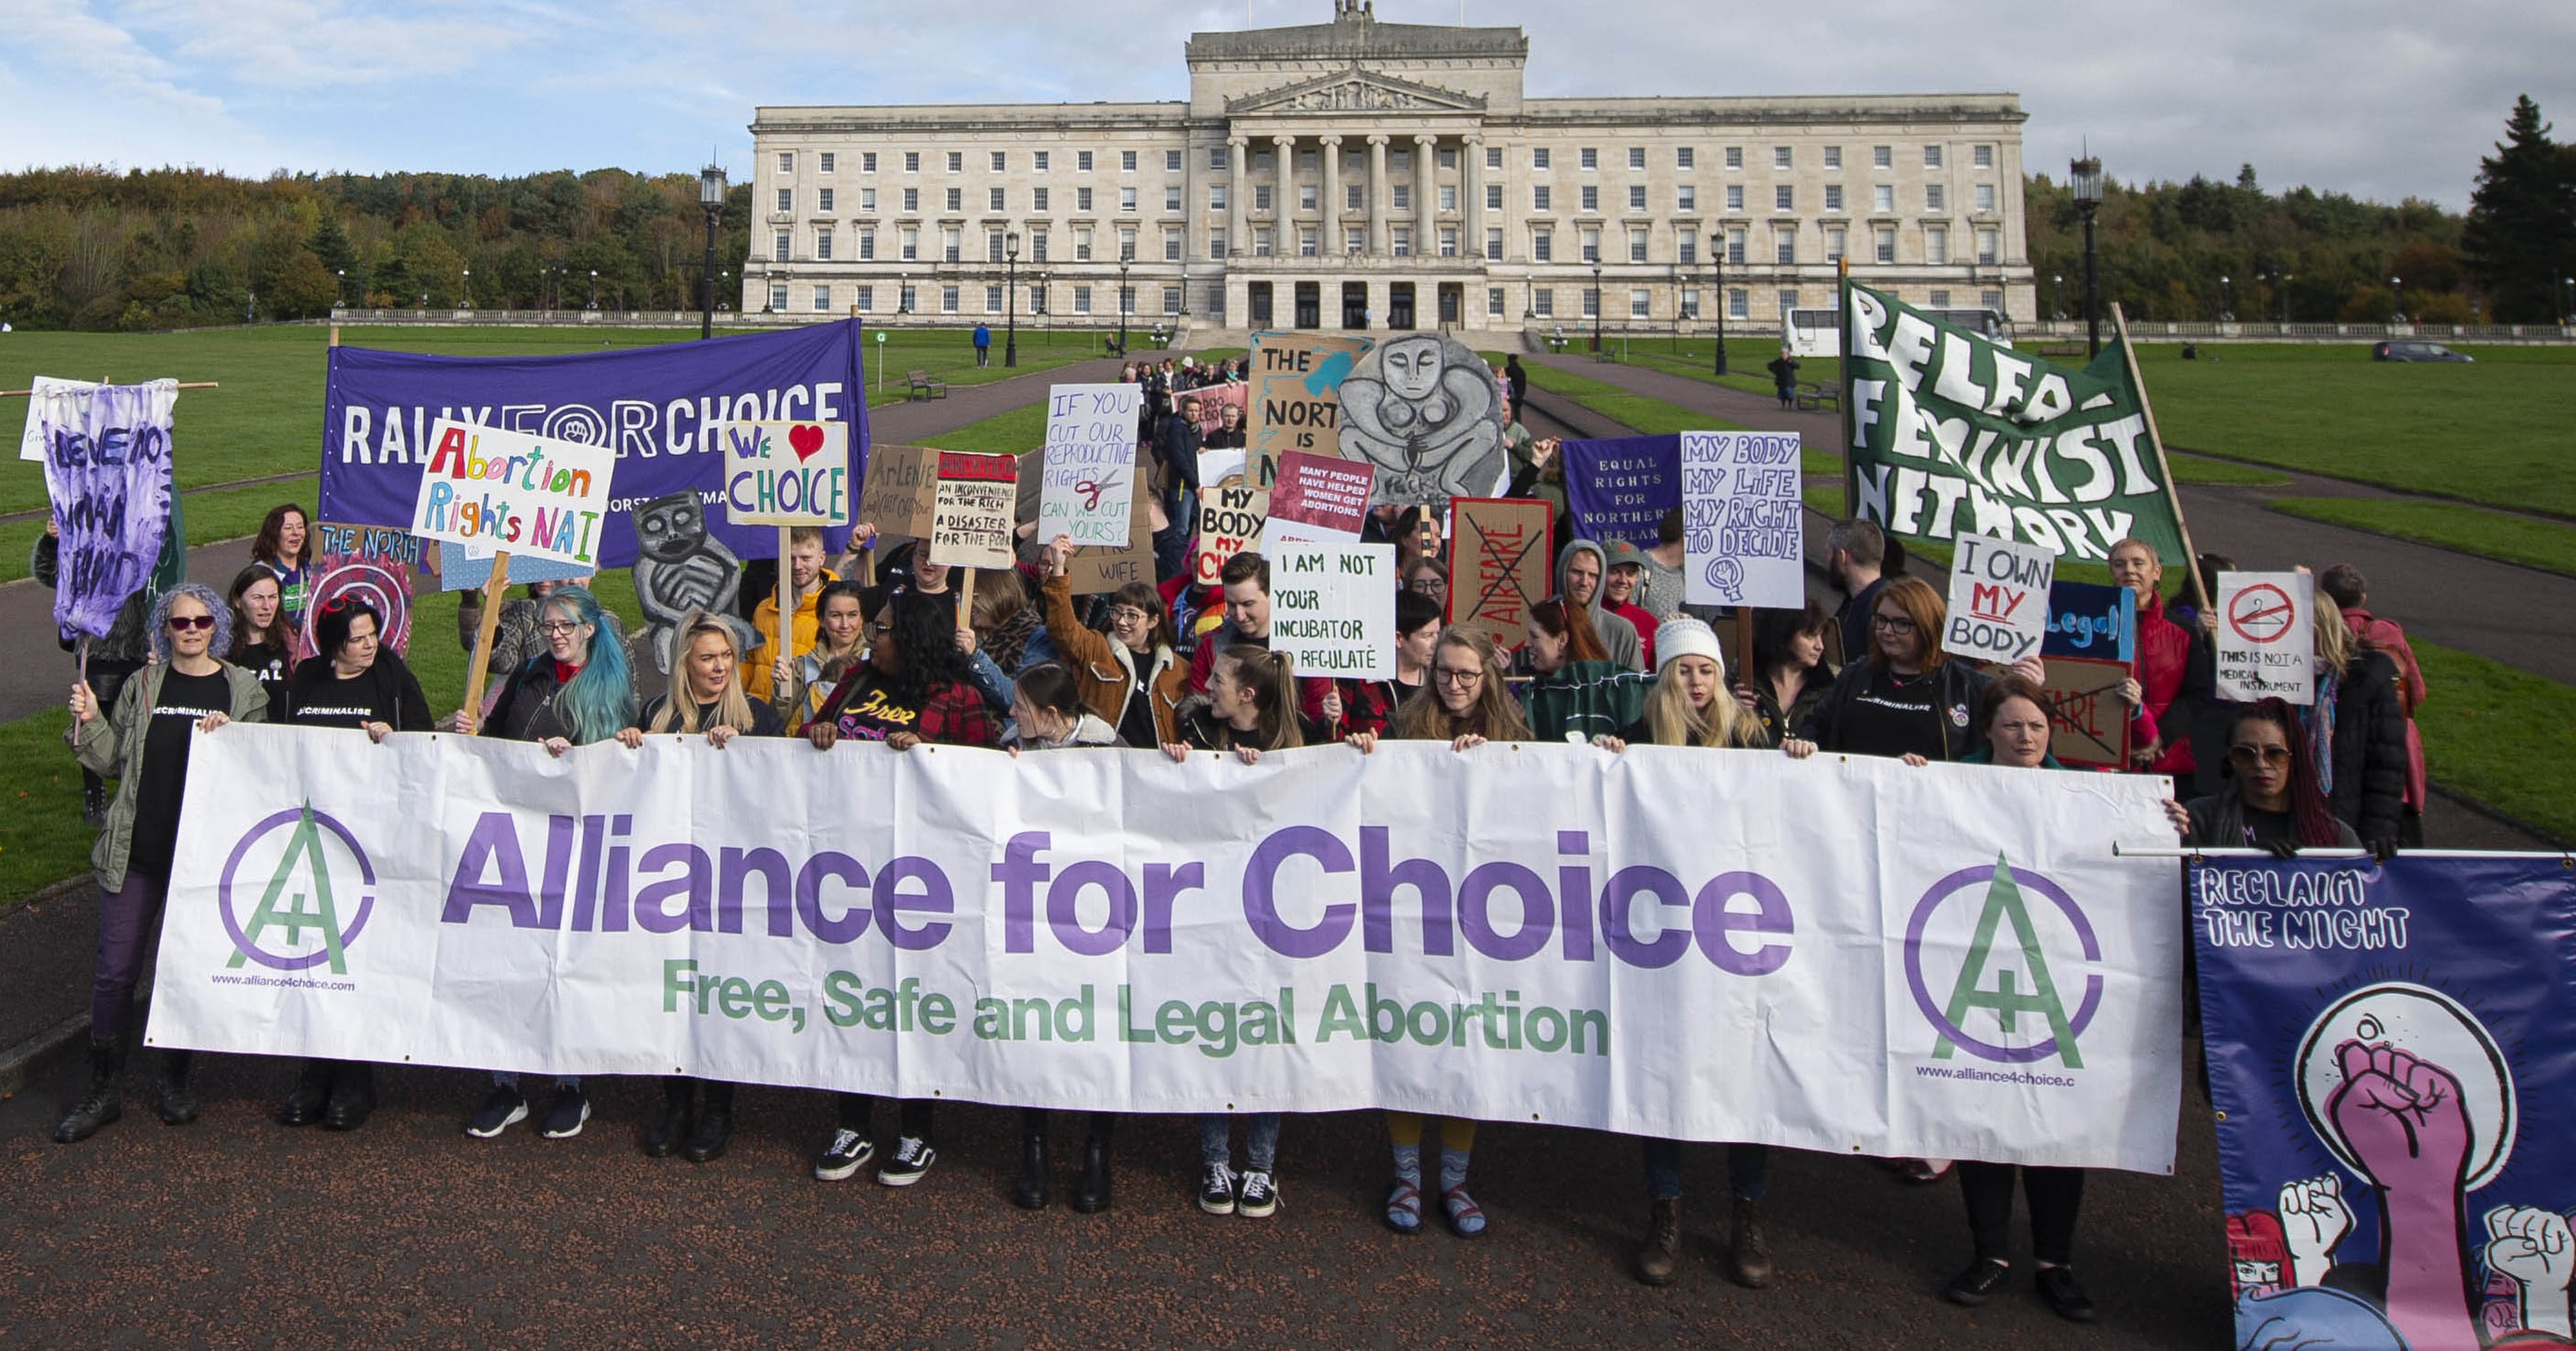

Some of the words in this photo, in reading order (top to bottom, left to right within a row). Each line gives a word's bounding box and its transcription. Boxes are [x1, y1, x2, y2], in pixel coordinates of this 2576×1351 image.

[1262, 348, 1312, 372] THE
[1053, 393, 1084, 417] IF
[1093, 392, 1131, 415] YOU
[1266, 400, 1337, 428] NORT
[343, 405, 491, 463] RAL
[1049, 424, 1080, 442] CUT
[1089, 422, 1123, 443] OUR
[1297, 433, 1314, 448] IS
[1045, 443, 1135, 466] REPRODUCTIVE
[1683, 436, 1730, 463] MY
[1733, 436, 1800, 464] BODY
[429, 427, 591, 497] Abortion
[1599, 457, 1656, 471] EQUAL
[1044, 468, 1099, 487] RIGHTS
[1299, 477, 1327, 489] HAVE
[1327, 482, 1366, 496] HELPED
[1300, 466, 1328, 478] MANY
[1330, 471, 1369, 486] PEOPLE
[1596, 474, 1662, 489] RIGHTS
[1684, 468, 1726, 495] MY
[729, 468, 845, 520] CHOICE
[938, 484, 951, 495] AN
[955, 484, 1014, 497] INCONVENIENCE
[1221, 489, 1253, 509] MY
[1304, 489, 1341, 502] WOMEN
[1343, 496, 1364, 506] GET
[1615, 494, 1646, 505] FOR
[938, 497, 955, 506] FOR
[958, 498, 975, 507] THE
[978, 497, 1004, 509] RICH
[1041, 502, 1069, 518] CAN
[1100, 502, 1130, 518] CUT
[1301, 499, 1360, 518] ABORTIONS.
[1684, 499, 1726, 527] MY
[425, 482, 521, 542] Rights
[531, 507, 599, 562] NAI
[936, 514, 944, 527] A
[948, 514, 1007, 530] DISASTER
[1202, 508, 1266, 538] BODY
[1584, 509, 1667, 524] NORTHER
[935, 532, 959, 545] FOR
[963, 532, 986, 545] THE
[989, 534, 1011, 547] POOR
[1068, 520, 1126, 542] YOURS?
[1596, 528, 1658, 542] IRELAN
[1684, 529, 1713, 554] TO
[319, 525, 356, 555] THE
[364, 527, 420, 565] NORTH
[1215, 536, 1244, 552] MY
[1098, 561, 1138, 581] WIFE
[1283, 555, 1287, 572] I
[1295, 553, 1325, 572] AM
[1339, 553, 1376, 575] NOT
[1480, 521, 1523, 626] AIRFARE
[1960, 541, 1980, 575] I
[1987, 550, 2051, 589] OWN
[1274, 589, 1319, 609] YOUR
[1971, 582, 2026, 618] MY
[1274, 620, 1363, 640] INCUBATOR
[1949, 617, 2038, 659] BODY
[2220, 651, 2247, 663] THIS
[2250, 651, 2261, 664] IS
[2265, 653, 2290, 664] NOT
[2293, 654, 2302, 665] A
[2240, 681, 2302, 692] INSTRUMENT
[153, 706, 222, 716] ECRIMINALI
[843, 689, 916, 725] Free
[441, 812, 955, 951] Alliance
[991, 831, 1204, 956] for
[1242, 825, 1794, 977] Choice
[2200, 868, 2365, 906] RECLAIM
[2203, 908, 2274, 947] THE
[2283, 908, 2410, 949] NIGHT
[212, 975, 355, 991] www.alliance4choice.com
[663, 958, 806, 1033] Free,
[822, 969, 957, 1035] Safe
[973, 983, 1095, 1042] and
[1118, 983, 1295, 1058] Legal
[1315, 981, 1608, 1056] Abortion
[1916, 1065, 2075, 1087] www.alliance4choice.c
